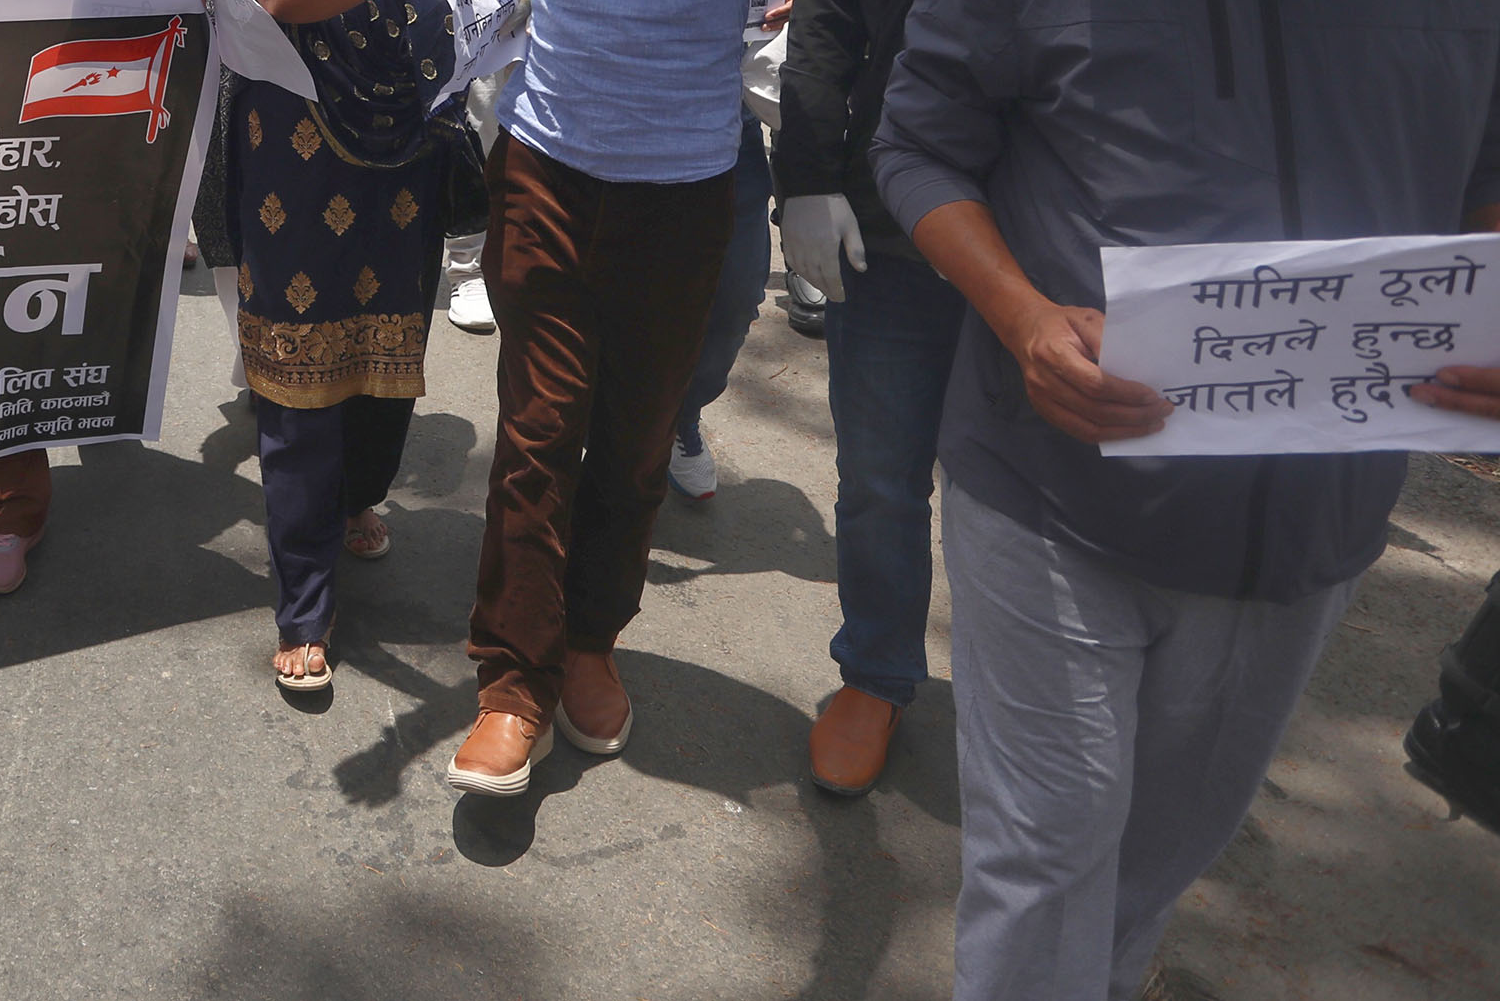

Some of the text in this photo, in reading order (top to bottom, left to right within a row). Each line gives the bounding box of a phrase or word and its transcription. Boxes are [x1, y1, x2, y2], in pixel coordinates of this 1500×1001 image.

[1190, 255, 1486, 309] मानिस ठूलो
[1193, 319, 1461, 364] दिलले हुन्छ
[63, 362, 110, 387] संघ
[1163, 369, 1303, 412] जातले
[34, 416, 74, 436] स्मृति
[78, 415, 116, 429] भवन
